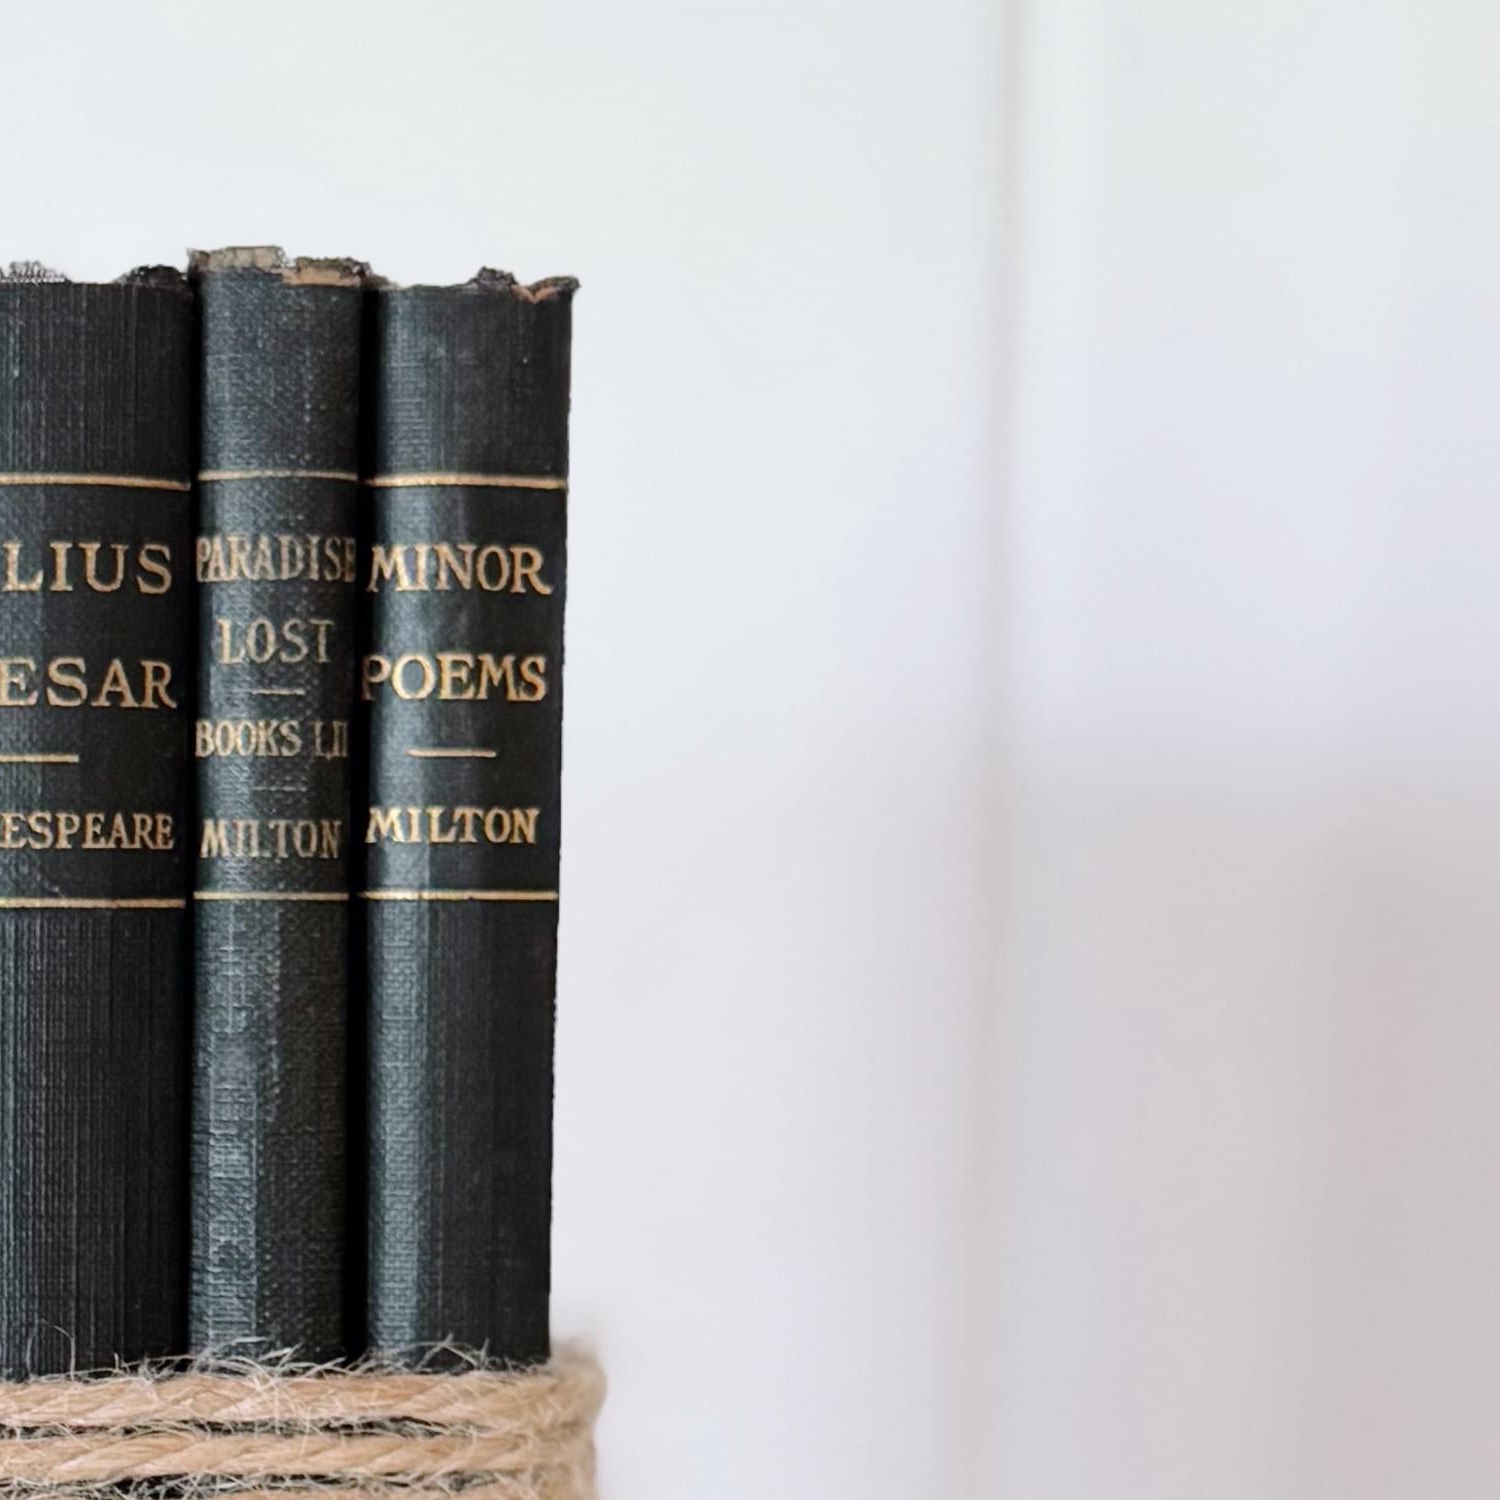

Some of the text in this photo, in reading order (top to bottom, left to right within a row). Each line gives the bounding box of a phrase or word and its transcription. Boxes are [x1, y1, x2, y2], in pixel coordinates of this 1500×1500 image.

[367, 543, 553, 595] MINOR
[218, 617, 335, 665] LOST
[362, 652, 546, 702] POEMS
[195, 719, 301, 757] BOOKS
[199, 818, 343, 860] MILTON
[366, 806, 540, 845] MILTON
